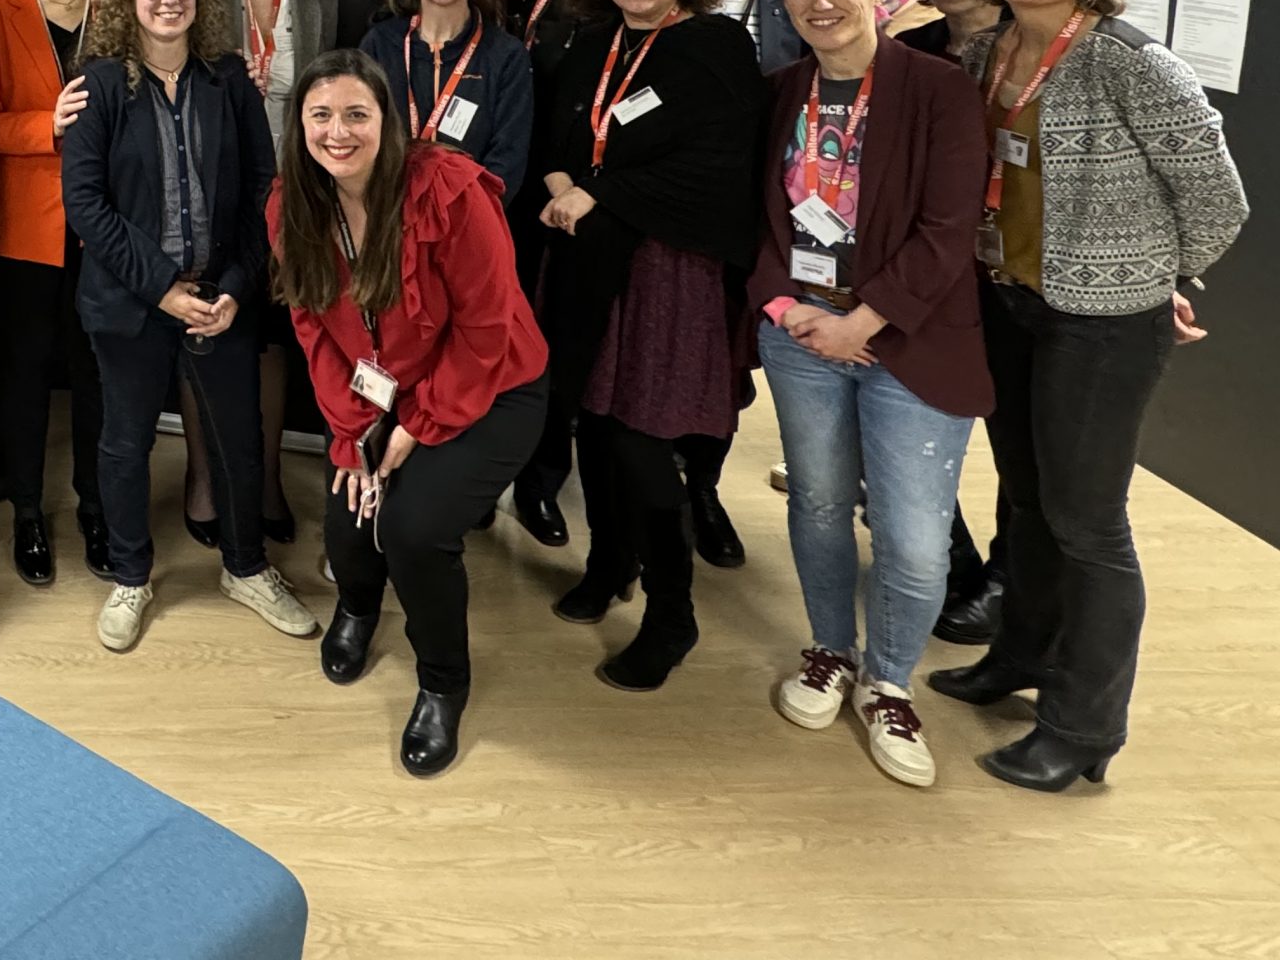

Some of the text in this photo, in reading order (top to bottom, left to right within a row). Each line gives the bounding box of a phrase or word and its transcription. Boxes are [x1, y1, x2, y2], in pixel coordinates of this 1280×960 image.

[1015, 66, 1050, 108] Visiteurs
[427, 94, 450, 128] Visiteurs
[846, 94, 869, 135] Visiteurs
[807, 122, 818, 163] Visiteurs
